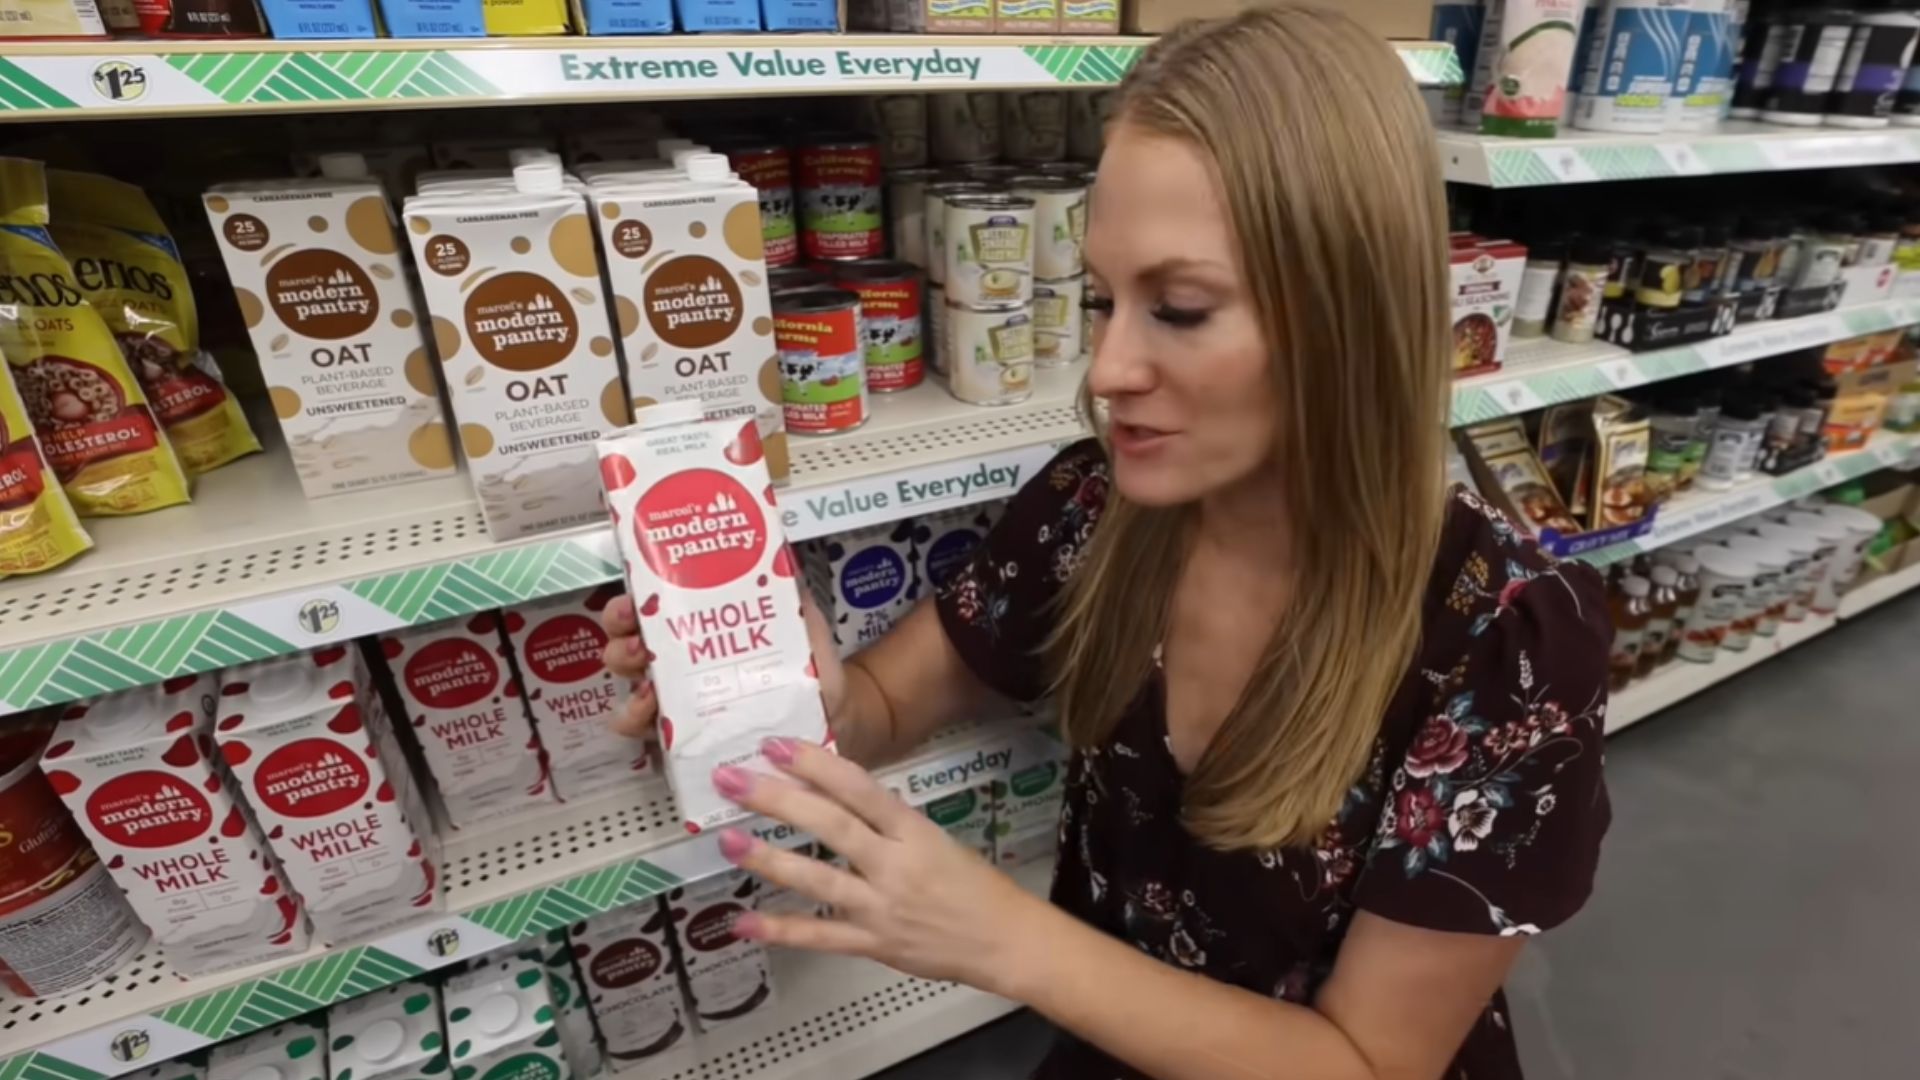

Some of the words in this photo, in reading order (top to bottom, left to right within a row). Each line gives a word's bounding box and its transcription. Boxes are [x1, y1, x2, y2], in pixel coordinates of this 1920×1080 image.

[560, 52, 718, 81] Extreme
[727, 49, 826, 78] Value
[836, 49, 981, 82] Everyday
[234, 221, 255, 234] 25
[519, 211, 539, 219] FREE
[622, 227, 641, 240] 25
[435, 243, 457, 256] 25
[73, 257, 173, 301] erios
[279, 275, 324, 288] marcel's
[277, 283, 364, 304] modern
[652, 292, 730, 312] modern
[863, 300, 900, 310] arms
[295, 299, 370, 320] pantry
[477, 301, 523, 315] marcel's
[666, 306, 736, 330] pantry
[34, 317, 75, 332] OATS
[475, 310, 563, 333] modern
[492, 327, 569, 351] pantry
[777, 332, 819, 344] arms
[311, 343, 372, 368] OAT
[674, 352, 731, 377] OAT
[301, 365, 394, 386] PLANT-BASED
[316, 378, 387, 396] BEVERAGE
[505, 374, 568, 402] OAT
[664, 375, 748, 396] PLANT-BASED
[306, 395, 407, 417] UNSWEETENED
[494, 399, 590, 422] PLANT-BASED
[510, 412, 581, 432] BEVERAGE
[45, 426, 141, 455] OLESTEROL
[498, 430, 601, 455] UNSWEETENED
[806, 489, 889, 521] Value
[896, 462, 1021, 503] Everyday
[648, 503, 703, 521] marcel's
[645, 512, 749, 545] modern
[666, 530, 756, 564] pantry
[845, 565, 898, 588] modern
[854, 575, 900, 598] pantry
[666, 595, 777, 642] WHOLE
[864, 609, 889, 626] 2%
[532, 637, 599, 662] modern
[687, 623, 773, 665] MILK
[545, 648, 604, 671] pantry
[413, 661, 486, 687] modern
[429, 671, 492, 697] pantry
[545, 683, 616, 713] WHOLE
[431, 707, 508, 740] WHOLE
[558, 698, 614, 724] MILK
[445, 724, 504, 751] MILK
[266, 763, 354, 796] modern
[907, 747, 1012, 793] Everyday
[285, 774, 361, 806] pantry
[100, 796, 195, 826] modern
[122, 808, 203, 836] pantry
[290, 813, 383, 851] WHOLE
[310, 832, 380, 863] MILK
[132, 848, 231, 881] WHOLE
[154, 865, 230, 894] MILK
